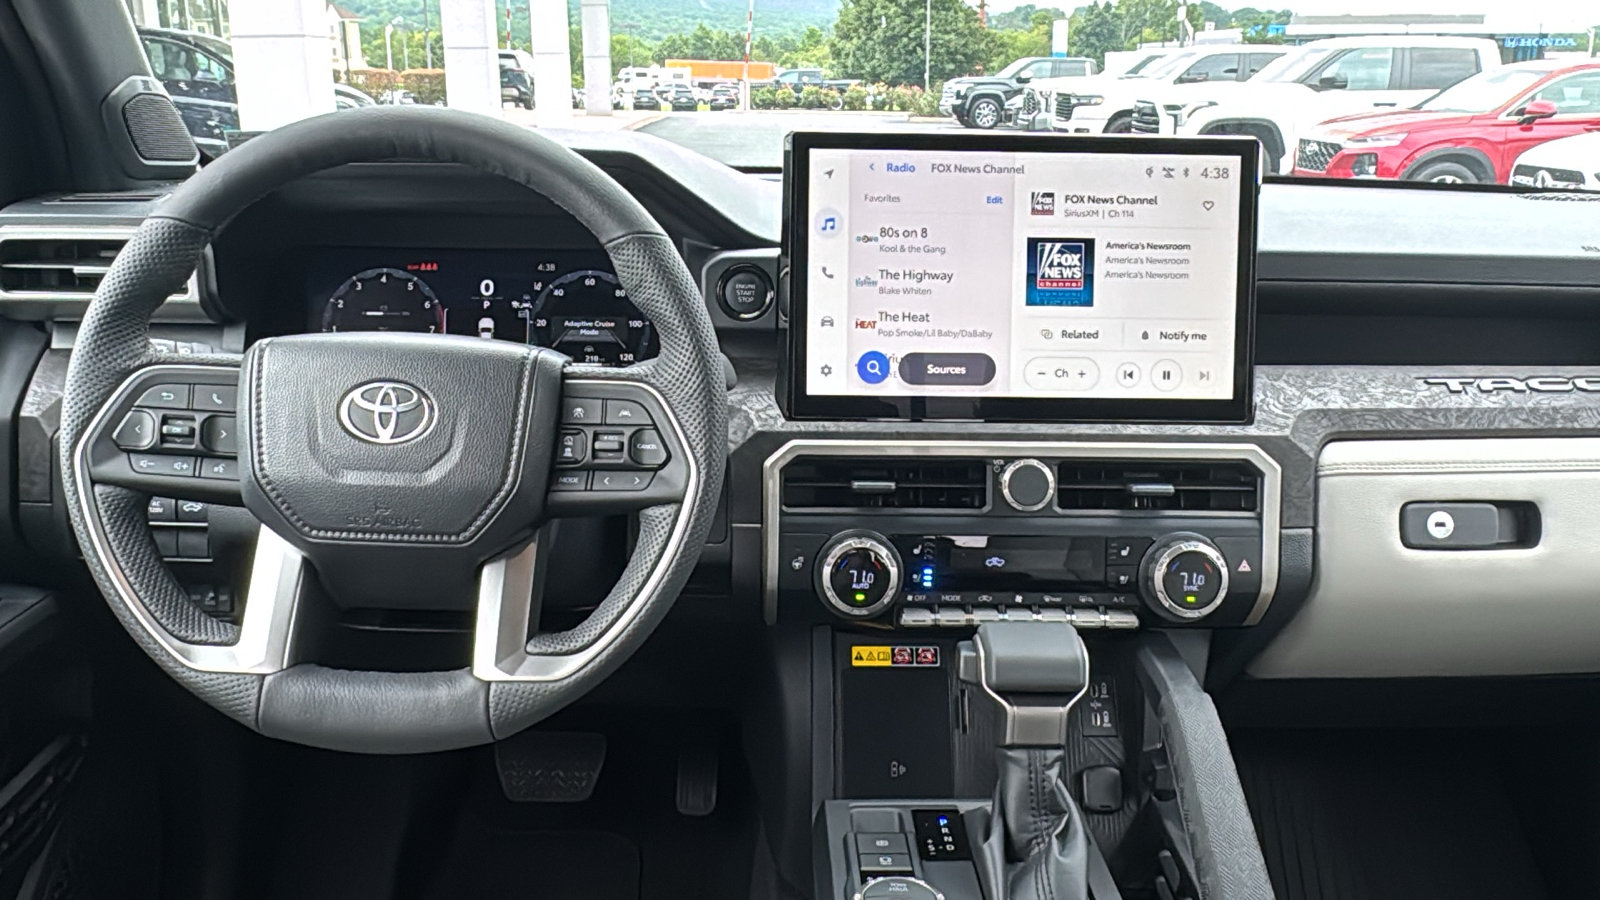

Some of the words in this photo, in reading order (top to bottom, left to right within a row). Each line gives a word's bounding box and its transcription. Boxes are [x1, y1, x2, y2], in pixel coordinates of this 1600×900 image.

[1518, 37, 1577, 47] HONDA
[886, 162, 916, 173] Radio
[931, 163, 952, 174] FOX
[954, 164, 981, 174] News
[983, 164, 1025, 175] Channel
[1200, 167, 1230, 180] 4:38
[864, 193, 900, 204] Favorites
[986, 195, 1003, 205] Edit
[1064, 194, 1085, 205] FOX
[1087, 195, 1115, 206] News
[1116, 195, 1158, 206] Channel
[1064, 208, 1099, 219] SiriusXM
[1107, 208, 1119, 219] Ch
[1120, 209, 1134, 219] 114
[879, 227, 899, 239] 80s
[902, 230, 916, 239] on
[920, 227, 928, 239] 8
[879, 244, 898, 254] Kool
[899, 245, 906, 254] &
[908, 244, 922, 254] the
[923, 245, 946, 256] Gang
[1105, 241, 1146, 251] America's
[1146, 241, 1191, 251] Newsroom
[1053, 253, 1081, 267] FOX
[1105, 256, 1144, 266] America's
[1145, 257, 1190, 266] Newsroom
[537, 263, 556, 272] 4:38
[878, 269, 900, 281] The
[902, 269, 954, 283] Highway
[1044, 267, 1082, 279] NEWS
[1104, 270, 1144, 280] America's
[1145, 271, 1190, 280] Newsroom
[380, 275, 387, 283] 4
[584, 278, 596, 286] 60
[1038, 280, 1082, 288] channel
[355, 282, 362, 290] 3
[407, 282, 414, 290] 5
[480, 279, 494, 296] 0
[552, 289, 564, 297] 40
[615, 290, 626, 298] 80
[878, 287, 900, 295] Blake
[902, 287, 932, 296] Whiten
[337, 300, 344, 308] 2
[424, 301, 431, 309] 6
[483, 300, 490, 309] P
[878, 311, 900, 322] The
[902, 312, 930, 323] Heat
[535, 319, 547, 327] 20
[564, 320, 592, 330] Adaptive
[594, 320, 616, 329] Cruise
[628, 320, 643, 328] 100
[855, 320, 877, 330] HEAT
[429, 325, 436, 333] 7
[579, 328, 599, 336] Mode
[878, 329, 895, 338] Pop
[895, 329, 936, 338] Smoke/Lil
[937, 329, 993, 340] Baby/DaBaby
[1061, 330, 1099, 340] Related
[1159, 331, 1190, 343] Notify
[584, 355, 599, 363] 210
[619, 353, 634, 361] 120
[927, 364, 966, 375] Sources
[1054, 368, 1069, 378] Ch
[852, 582, 870, 590] AUTO
[941, 594, 961, 602] MODE
[928, 844, 935, 852] S
